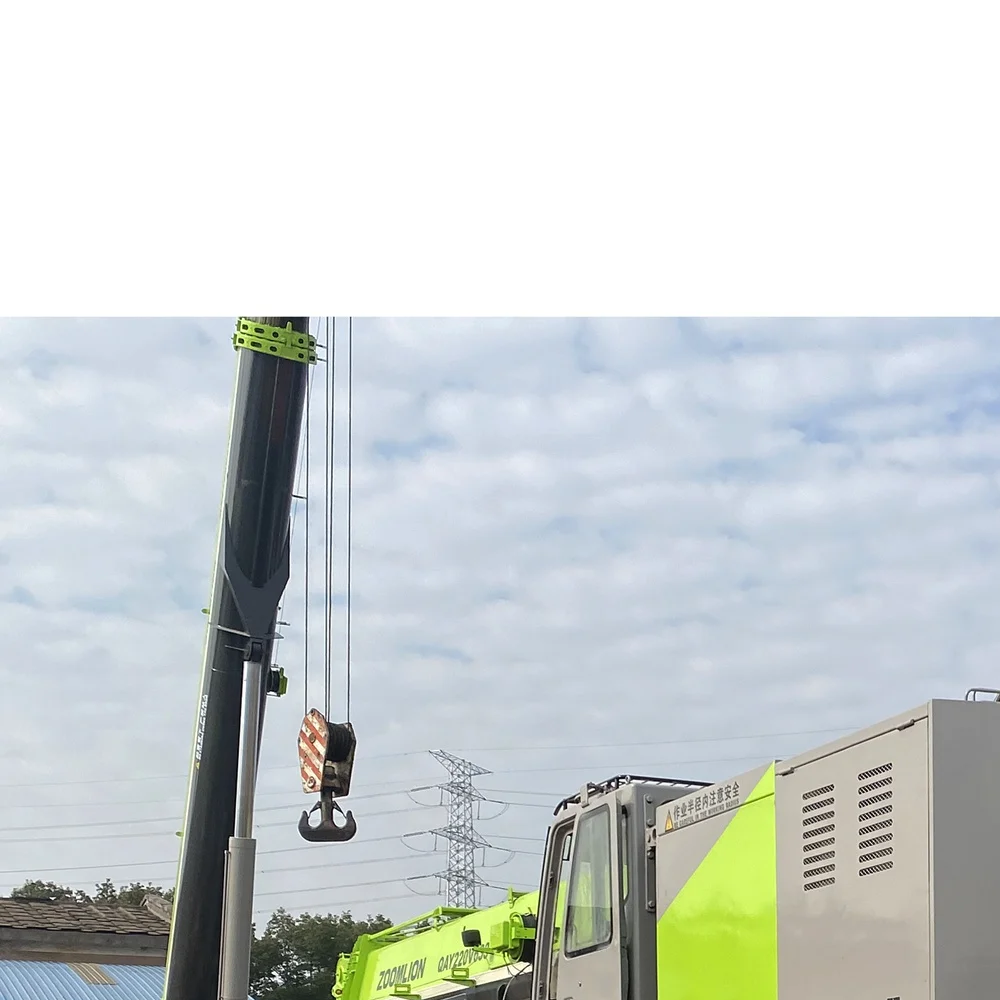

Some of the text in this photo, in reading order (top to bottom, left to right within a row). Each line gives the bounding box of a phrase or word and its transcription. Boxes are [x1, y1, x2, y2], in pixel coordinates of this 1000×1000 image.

[674, 781, 740, 820] 作业半径内注意安全
[376, 957, 427, 991] ZOOMLION
